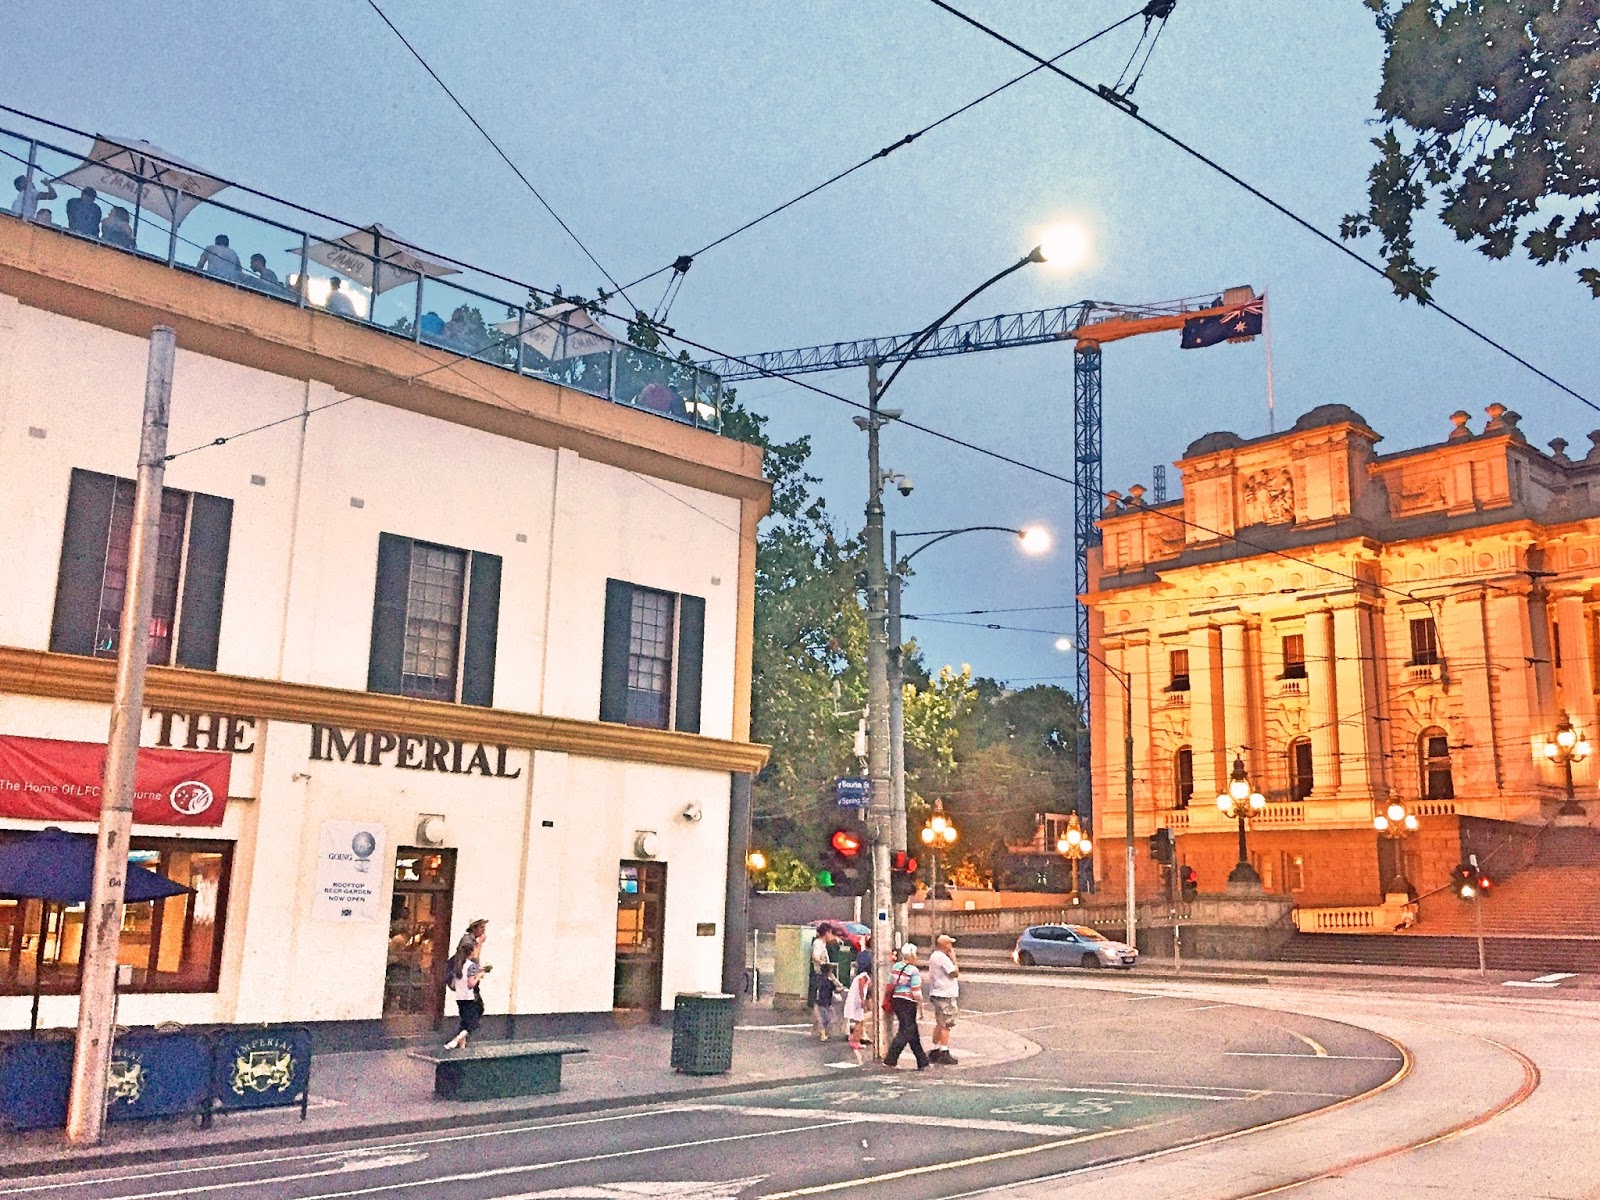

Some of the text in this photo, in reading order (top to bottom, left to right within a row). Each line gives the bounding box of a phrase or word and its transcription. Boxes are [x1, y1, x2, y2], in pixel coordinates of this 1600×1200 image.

[148, 707, 521, 779] THE IMPERIAL
[0, 779, 20, 791] The
[24, 781, 58, 794] Home
[62, 783, 75, 795] Of
[77, 785, 100, 797] LFC
[328, 852, 353, 861] GOING
